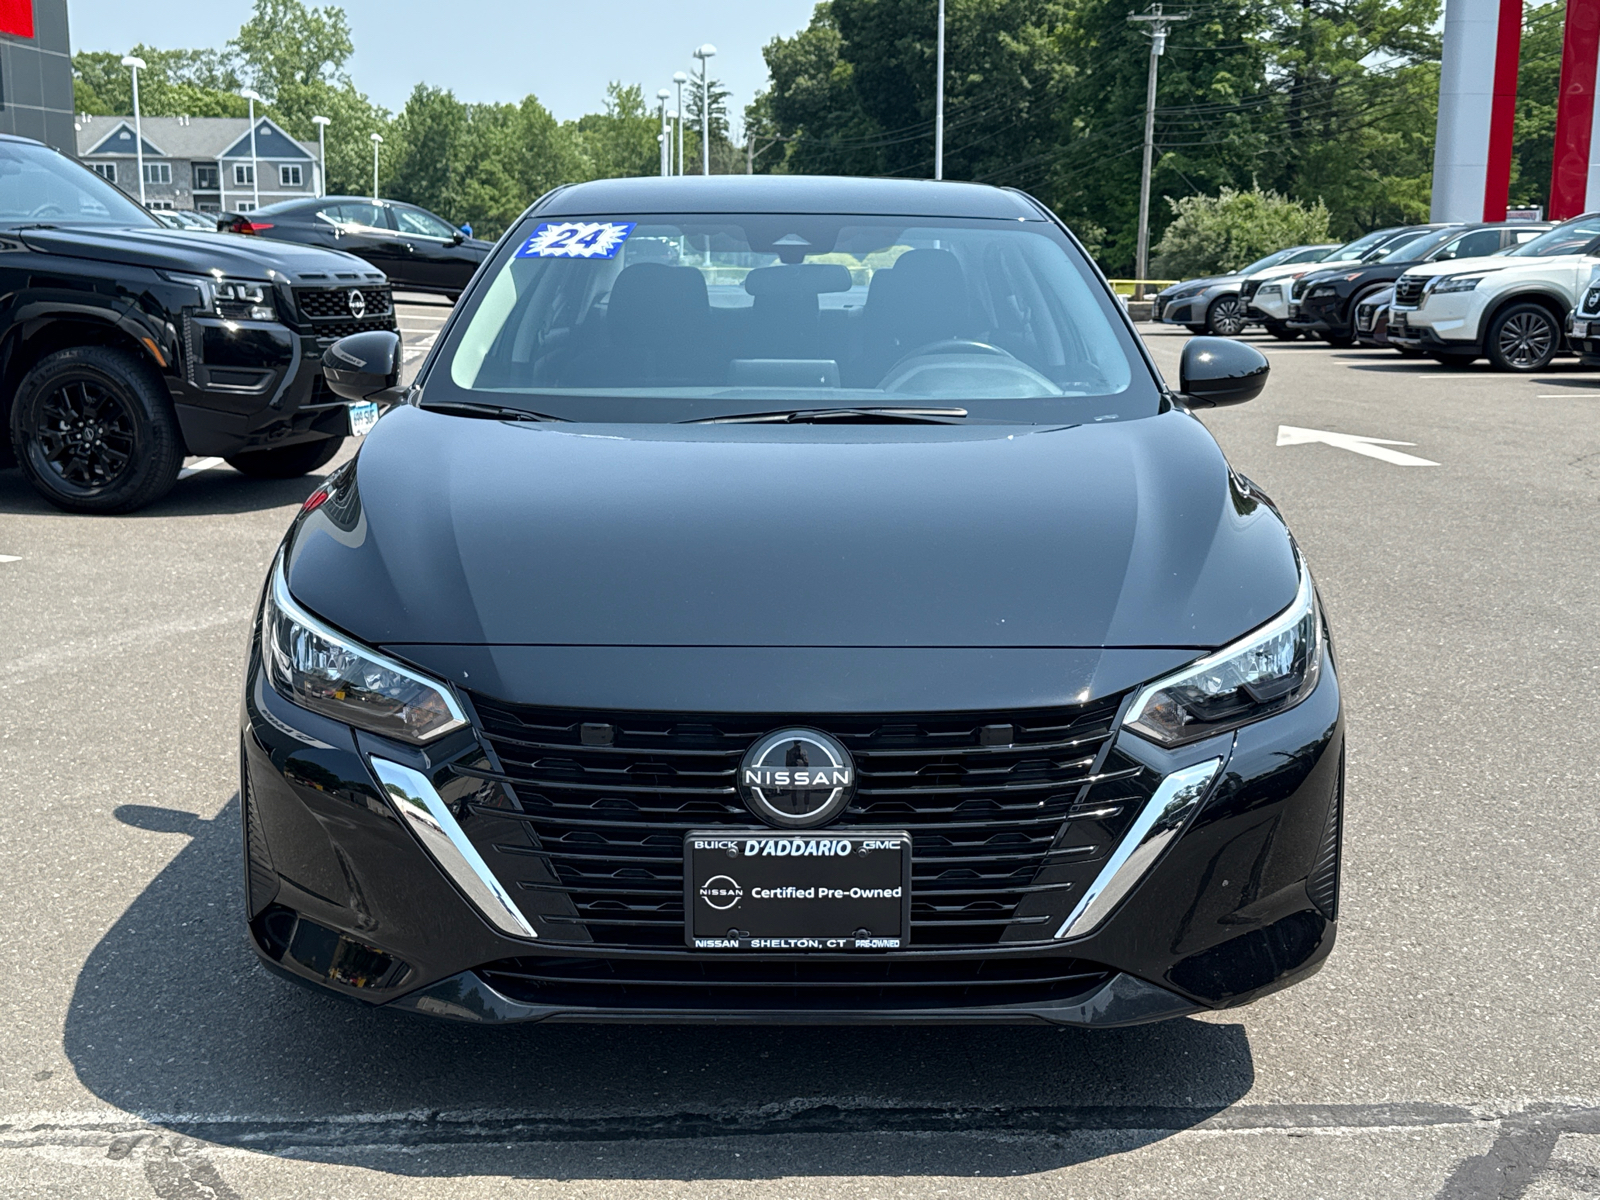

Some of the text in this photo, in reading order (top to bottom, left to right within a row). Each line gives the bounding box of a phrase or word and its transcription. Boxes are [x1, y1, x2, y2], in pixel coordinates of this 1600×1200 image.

[545, 229, 605, 249] 24
[745, 770, 849, 785] NISSAN
[694, 839, 901, 857] BUICK D'ADDARIO GMC
[699, 888, 743, 896] NISSAN
[751, 886, 902, 899] Certified Pre-Owned
[695, 939, 900, 949] NISSAN SHELTON, CT PRE-OWNED
